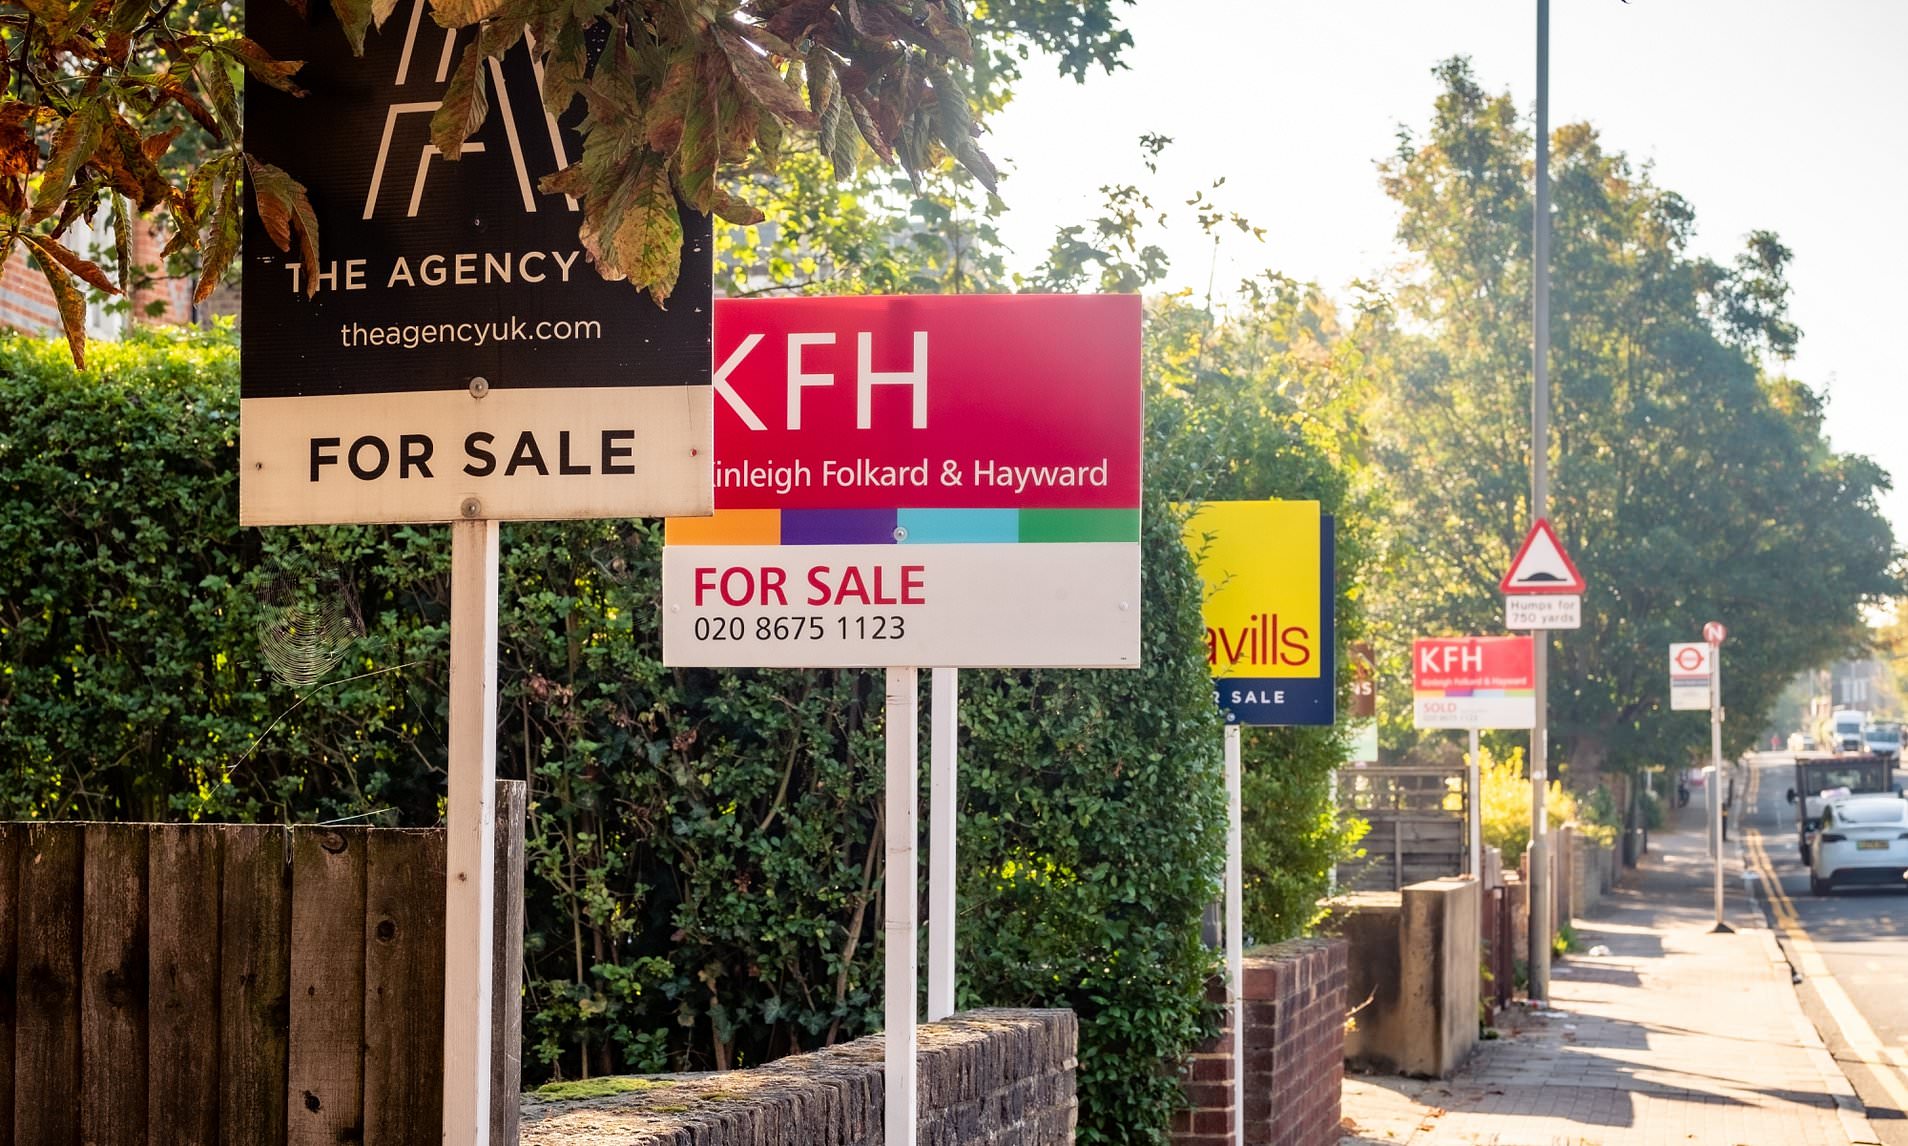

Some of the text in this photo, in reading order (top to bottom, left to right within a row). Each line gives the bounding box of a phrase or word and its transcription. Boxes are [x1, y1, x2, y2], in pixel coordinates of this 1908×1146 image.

[285, 251, 580, 293] THE AGENCY
[341, 316, 601, 348] theagencyuk.com
[713, 331, 928, 431] KFH
[311, 430, 635, 482] FOR SALE
[713, 458, 1108, 494] inleigh Folkard & Hayward
[695, 566, 926, 606] FOR SALE
[1511, 601, 1552, 612] Humps
[695, 616, 905, 641] 020 8675 1123
[1206, 613, 1310, 667] avills
[1421, 646, 1483, 673] KFH
[1231, 691, 1285, 704] SALE
[1424, 703, 1456, 713] SOLD
